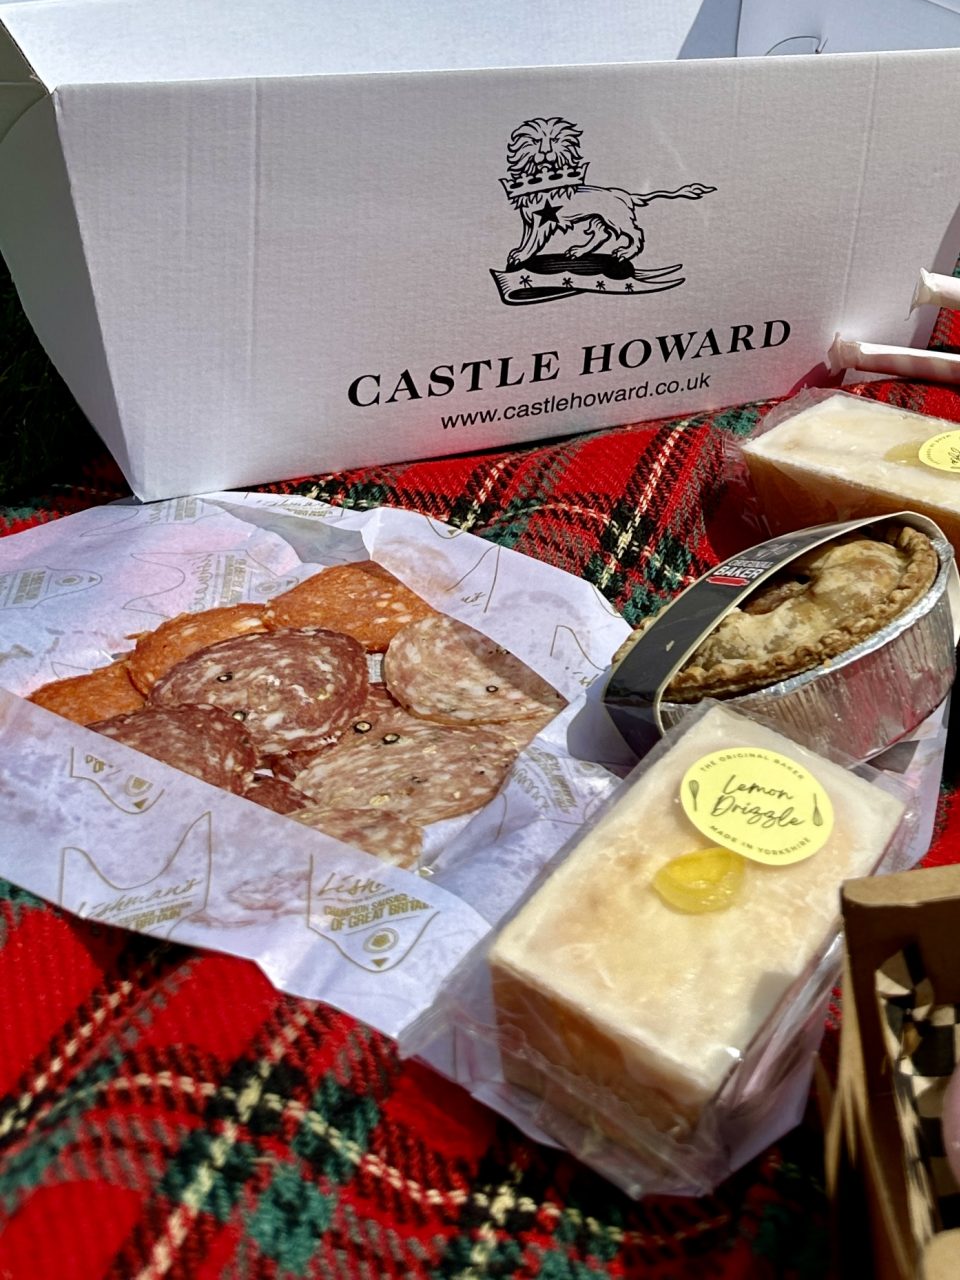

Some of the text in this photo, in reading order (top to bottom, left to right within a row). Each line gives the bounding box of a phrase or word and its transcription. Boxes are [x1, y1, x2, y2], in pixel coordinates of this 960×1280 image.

[347, 319, 792, 408] CASTLE HOWARD
[441, 372, 712, 430] www.castlehoward.co.uk
[713, 565, 765, 579] BAKER
[699, 760, 717, 773] THE
[773, 758, 805, 780] BAKER
[722, 774, 794, 801] Lemon
[710, 795, 807, 829] Drizzle
[709, 825, 812, 856] MADE IN YORKSHIRE
